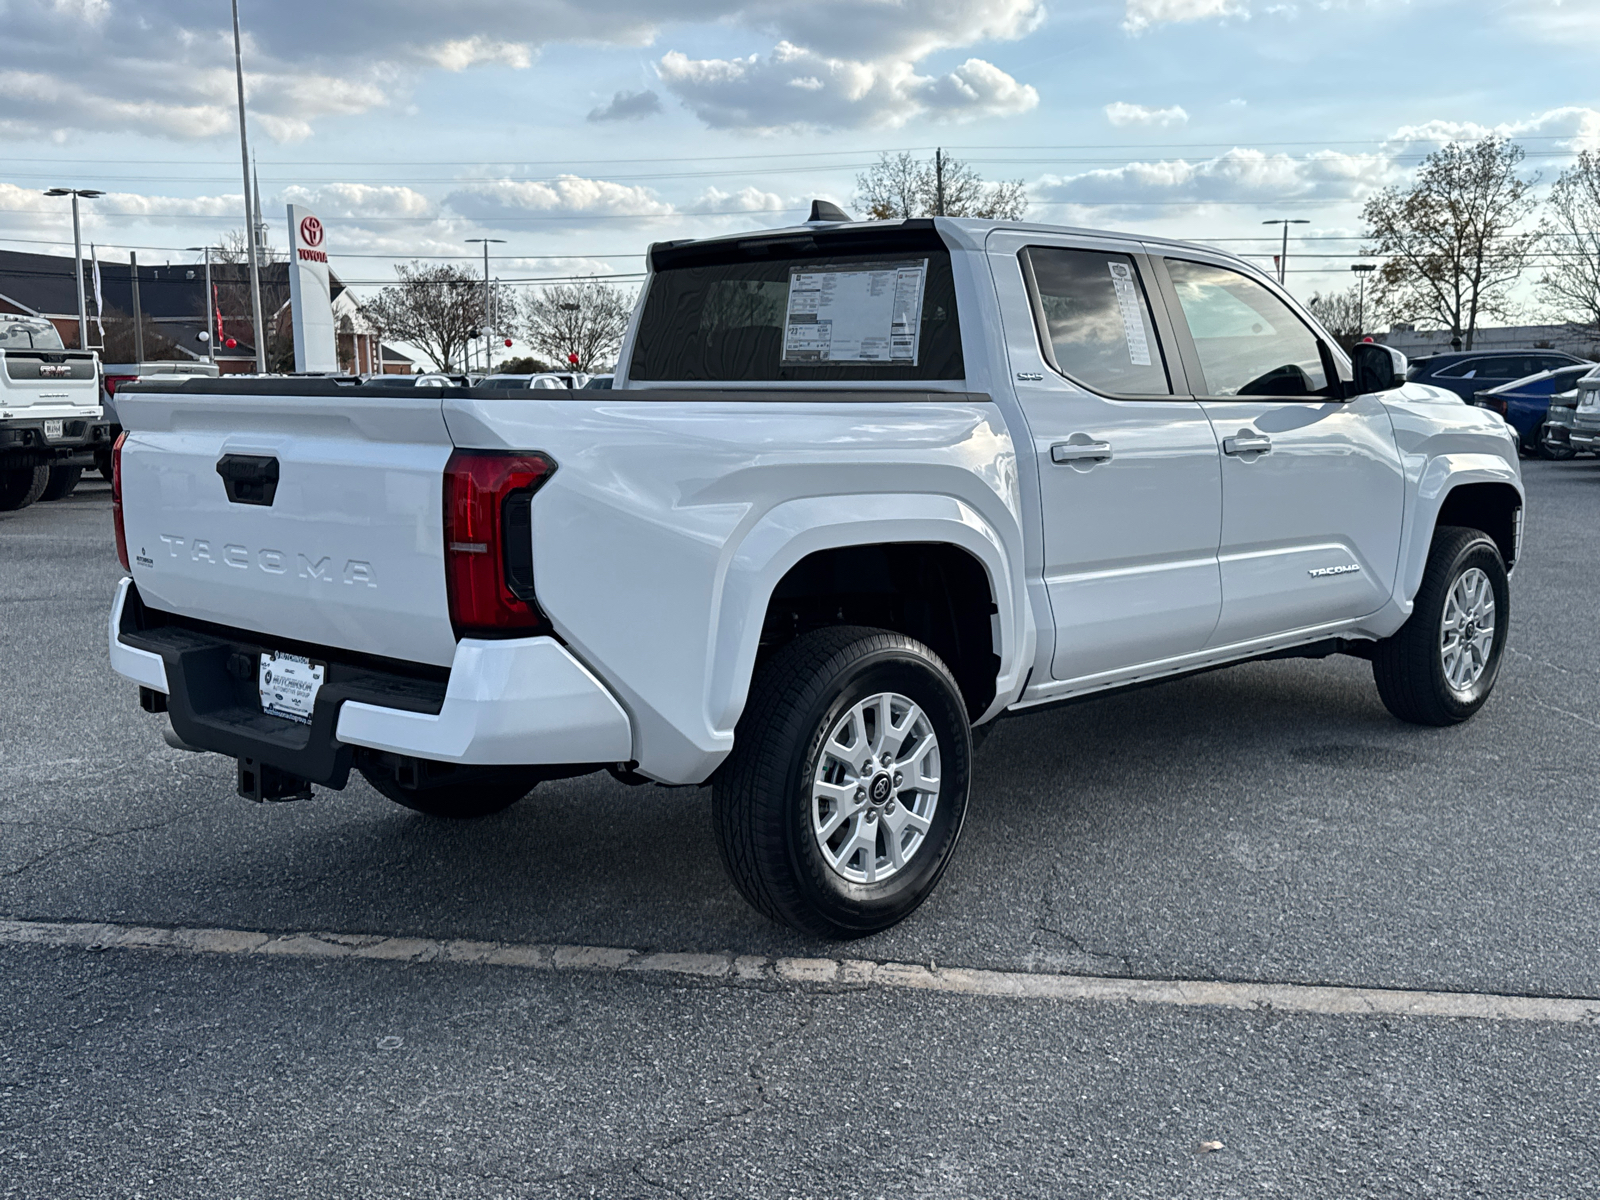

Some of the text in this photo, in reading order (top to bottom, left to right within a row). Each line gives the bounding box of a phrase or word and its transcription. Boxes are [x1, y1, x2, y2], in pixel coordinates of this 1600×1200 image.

[297, 248, 328, 263] TOYOTA
[160, 533, 378, 588] TACOMA
[1307, 563, 1360, 578] TACOMA
